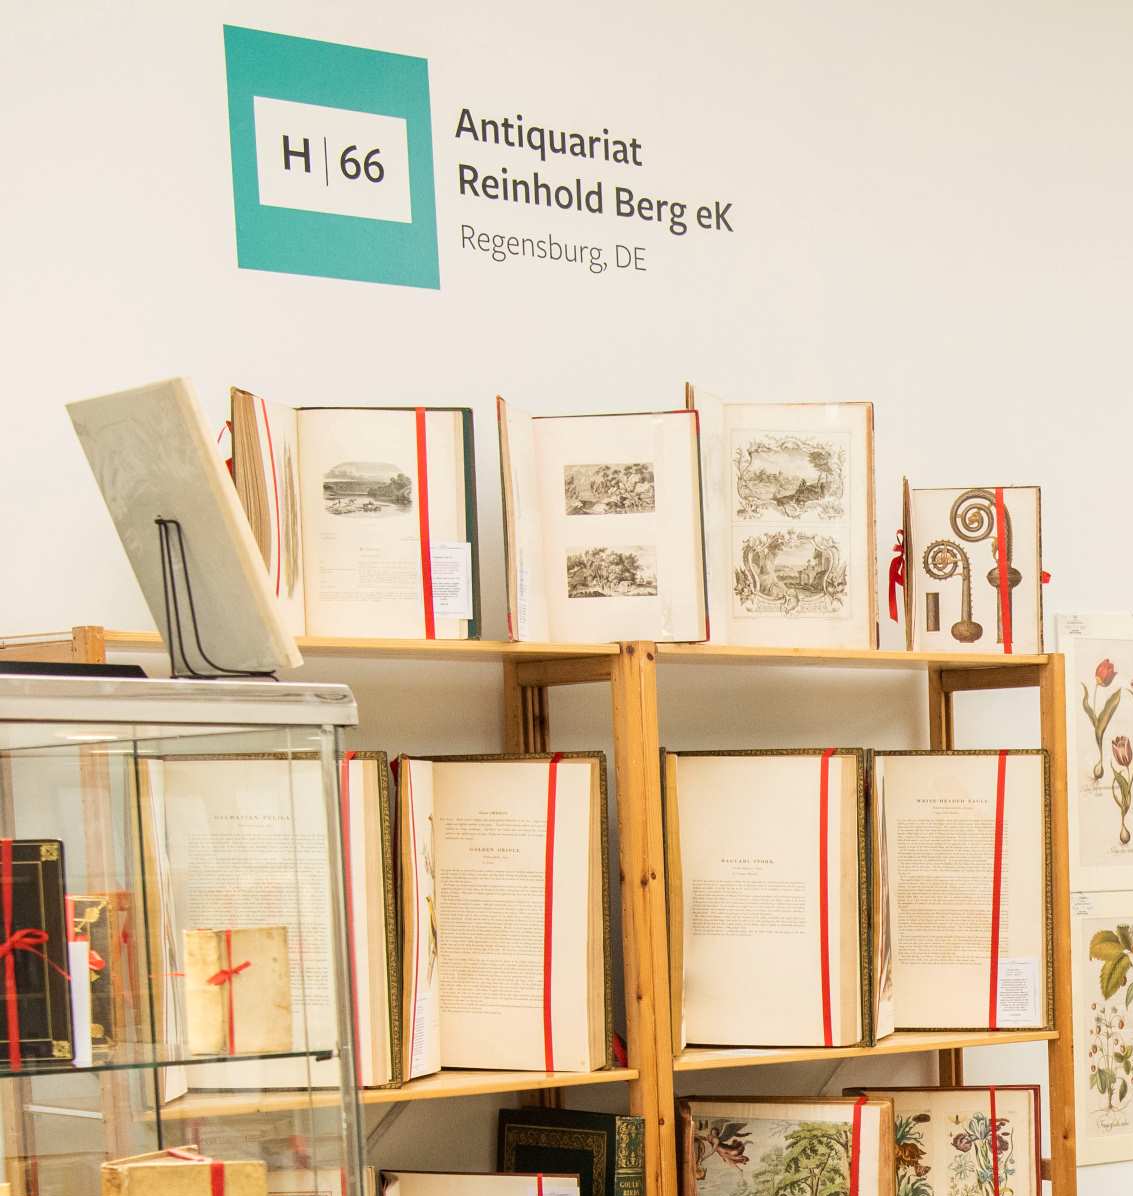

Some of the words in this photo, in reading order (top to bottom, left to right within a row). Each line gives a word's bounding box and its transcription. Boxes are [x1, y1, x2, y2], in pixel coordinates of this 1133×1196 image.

[282, 135, 312, 173] H
[340, 144, 385, 183] 66
[455, 108, 643, 167] Antiquariat
[458, 164, 604, 214] Reinhold
[615, 187, 687, 236] Berg
[696, 202, 734, 232] eK
[460, 224, 607, 274] Regensburg,
[616, 245, 647, 271] DE
